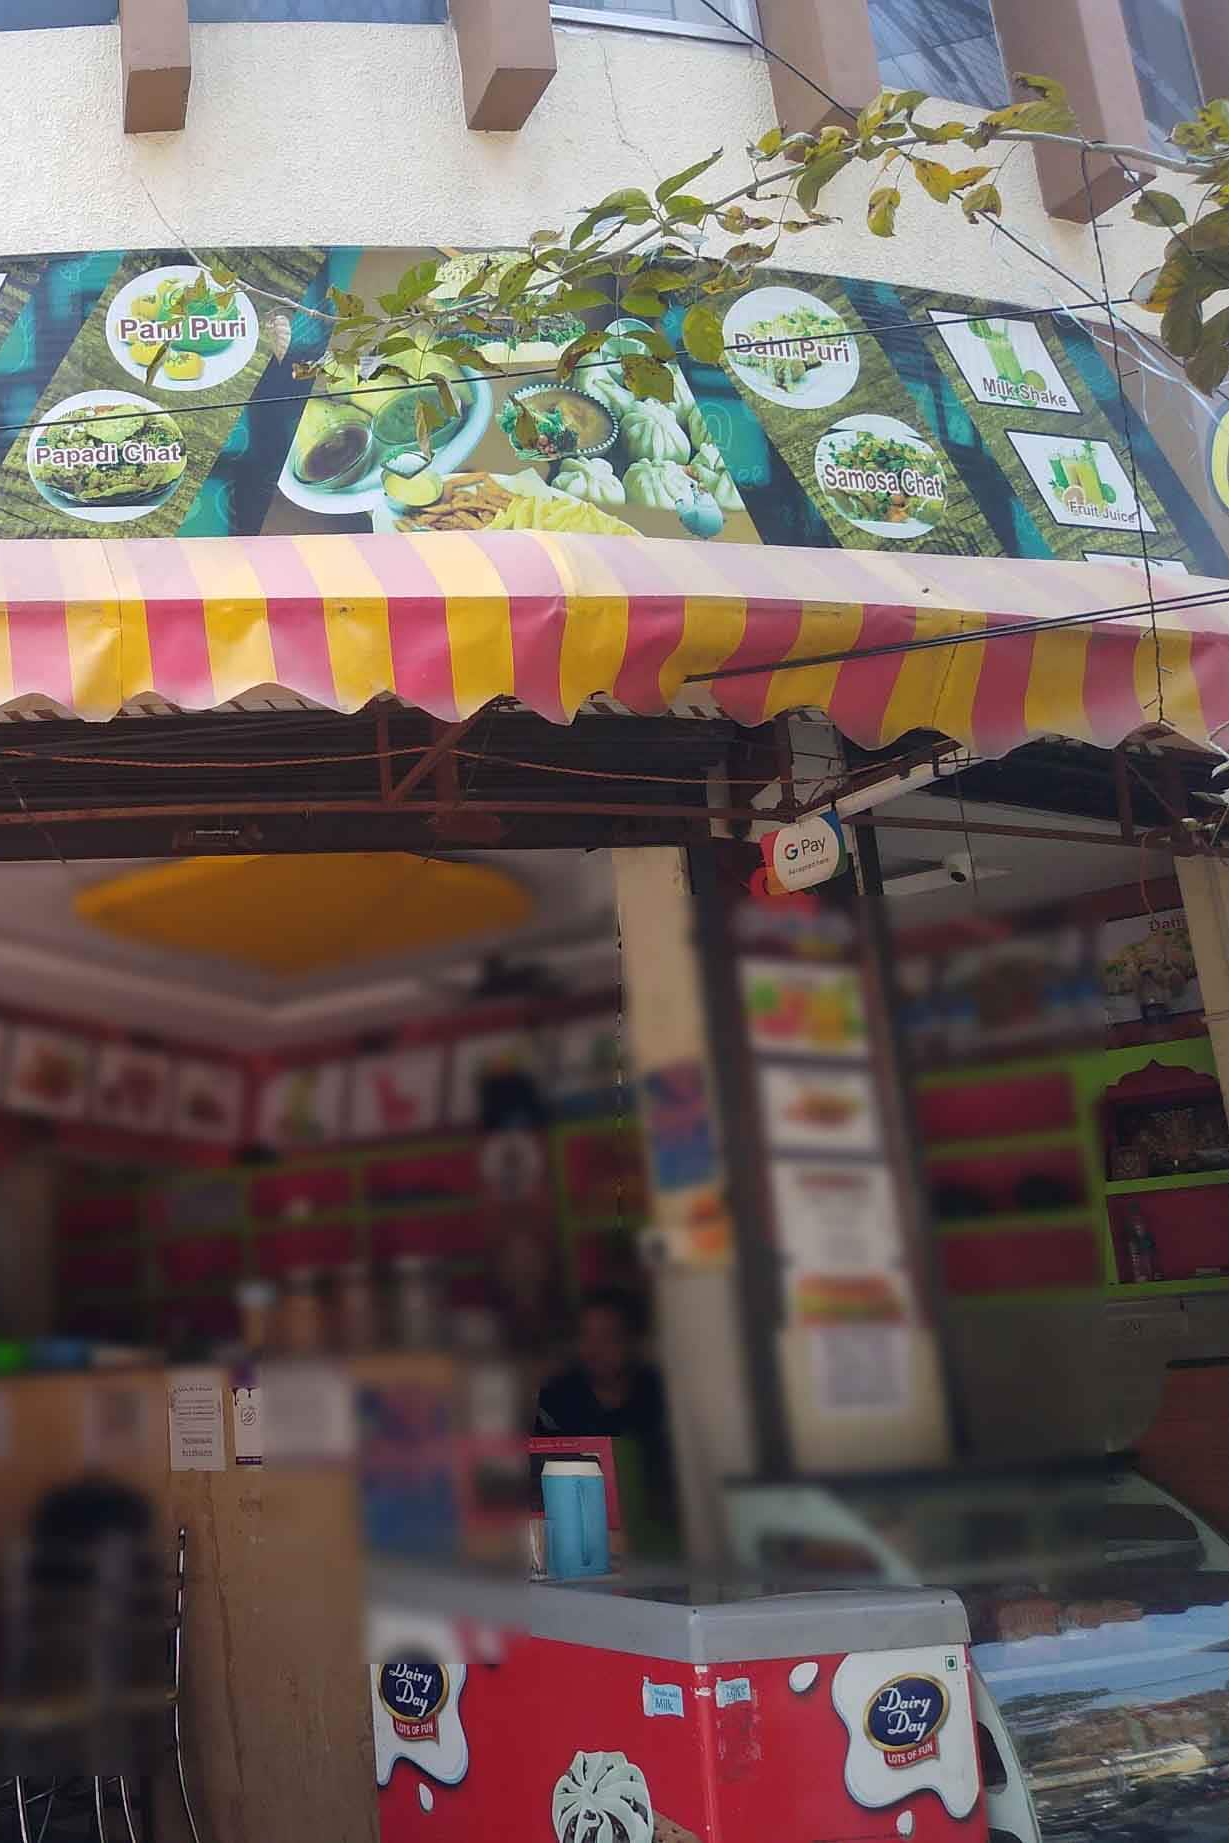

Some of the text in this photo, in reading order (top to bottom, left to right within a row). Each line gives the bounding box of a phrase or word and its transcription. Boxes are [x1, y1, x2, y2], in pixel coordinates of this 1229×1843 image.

[189, 316, 247, 339] Puri
[798, 336, 851, 363] Puri
[982, 377, 1068, 407] Milk Shake
[35, 443, 181, 467] Papadi Chat
[823, 463, 943, 500] Samosa Chat
[1070, 500, 1135, 523] Fruit Juice
[800, 835, 827, 857] Pay
[388, 1664, 432, 1693] Dairy
[395, 1678, 429, 1717] Day
[655, 1698, 674, 1712] Milk
[878, 1687, 931, 1718] Dairy
[887, 1709, 927, 1742] Day
[887, 1743, 933, 1765] LOTS OF FUN
